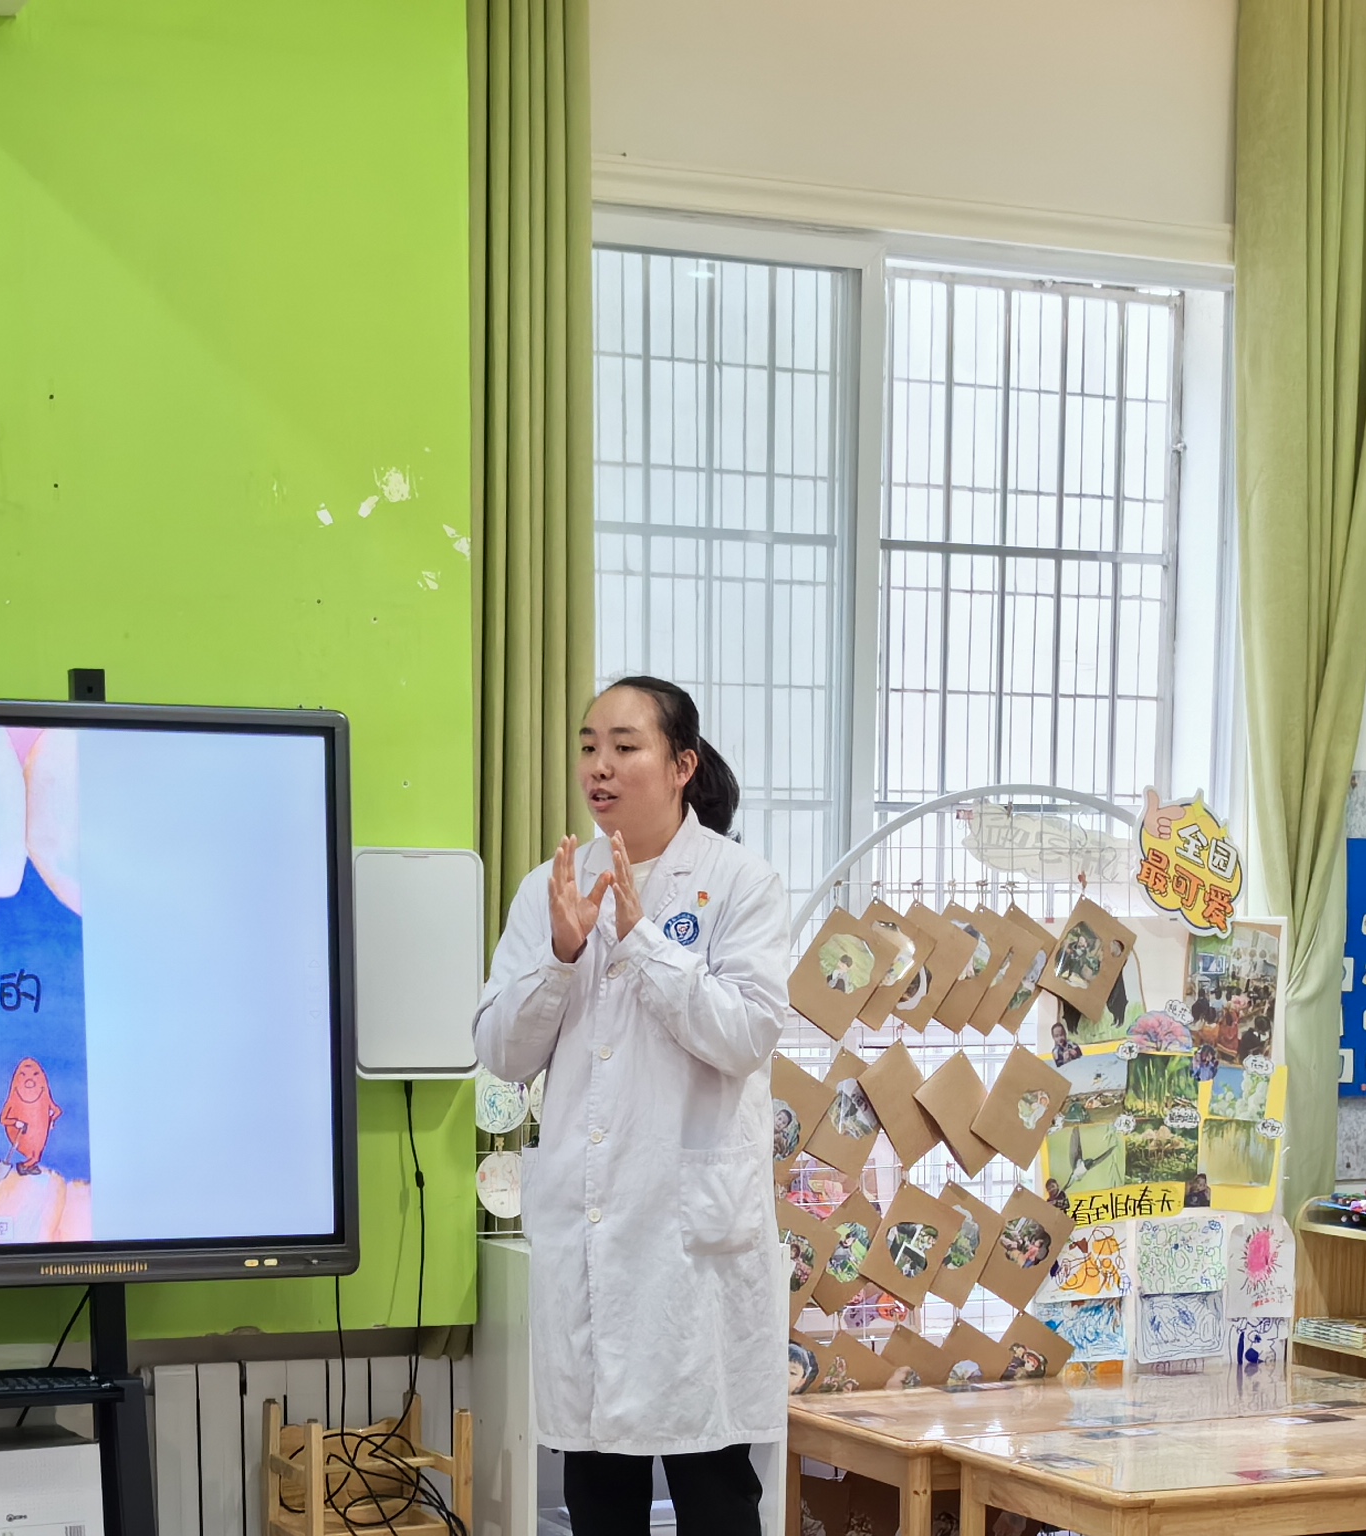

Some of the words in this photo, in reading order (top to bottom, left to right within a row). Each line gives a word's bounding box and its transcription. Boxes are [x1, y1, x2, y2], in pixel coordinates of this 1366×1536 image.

[1175, 823, 1238, 883] 全园
[1137, 848, 1234, 933] 最可爱
[1064, 1186, 1175, 1225] 看到的春天
